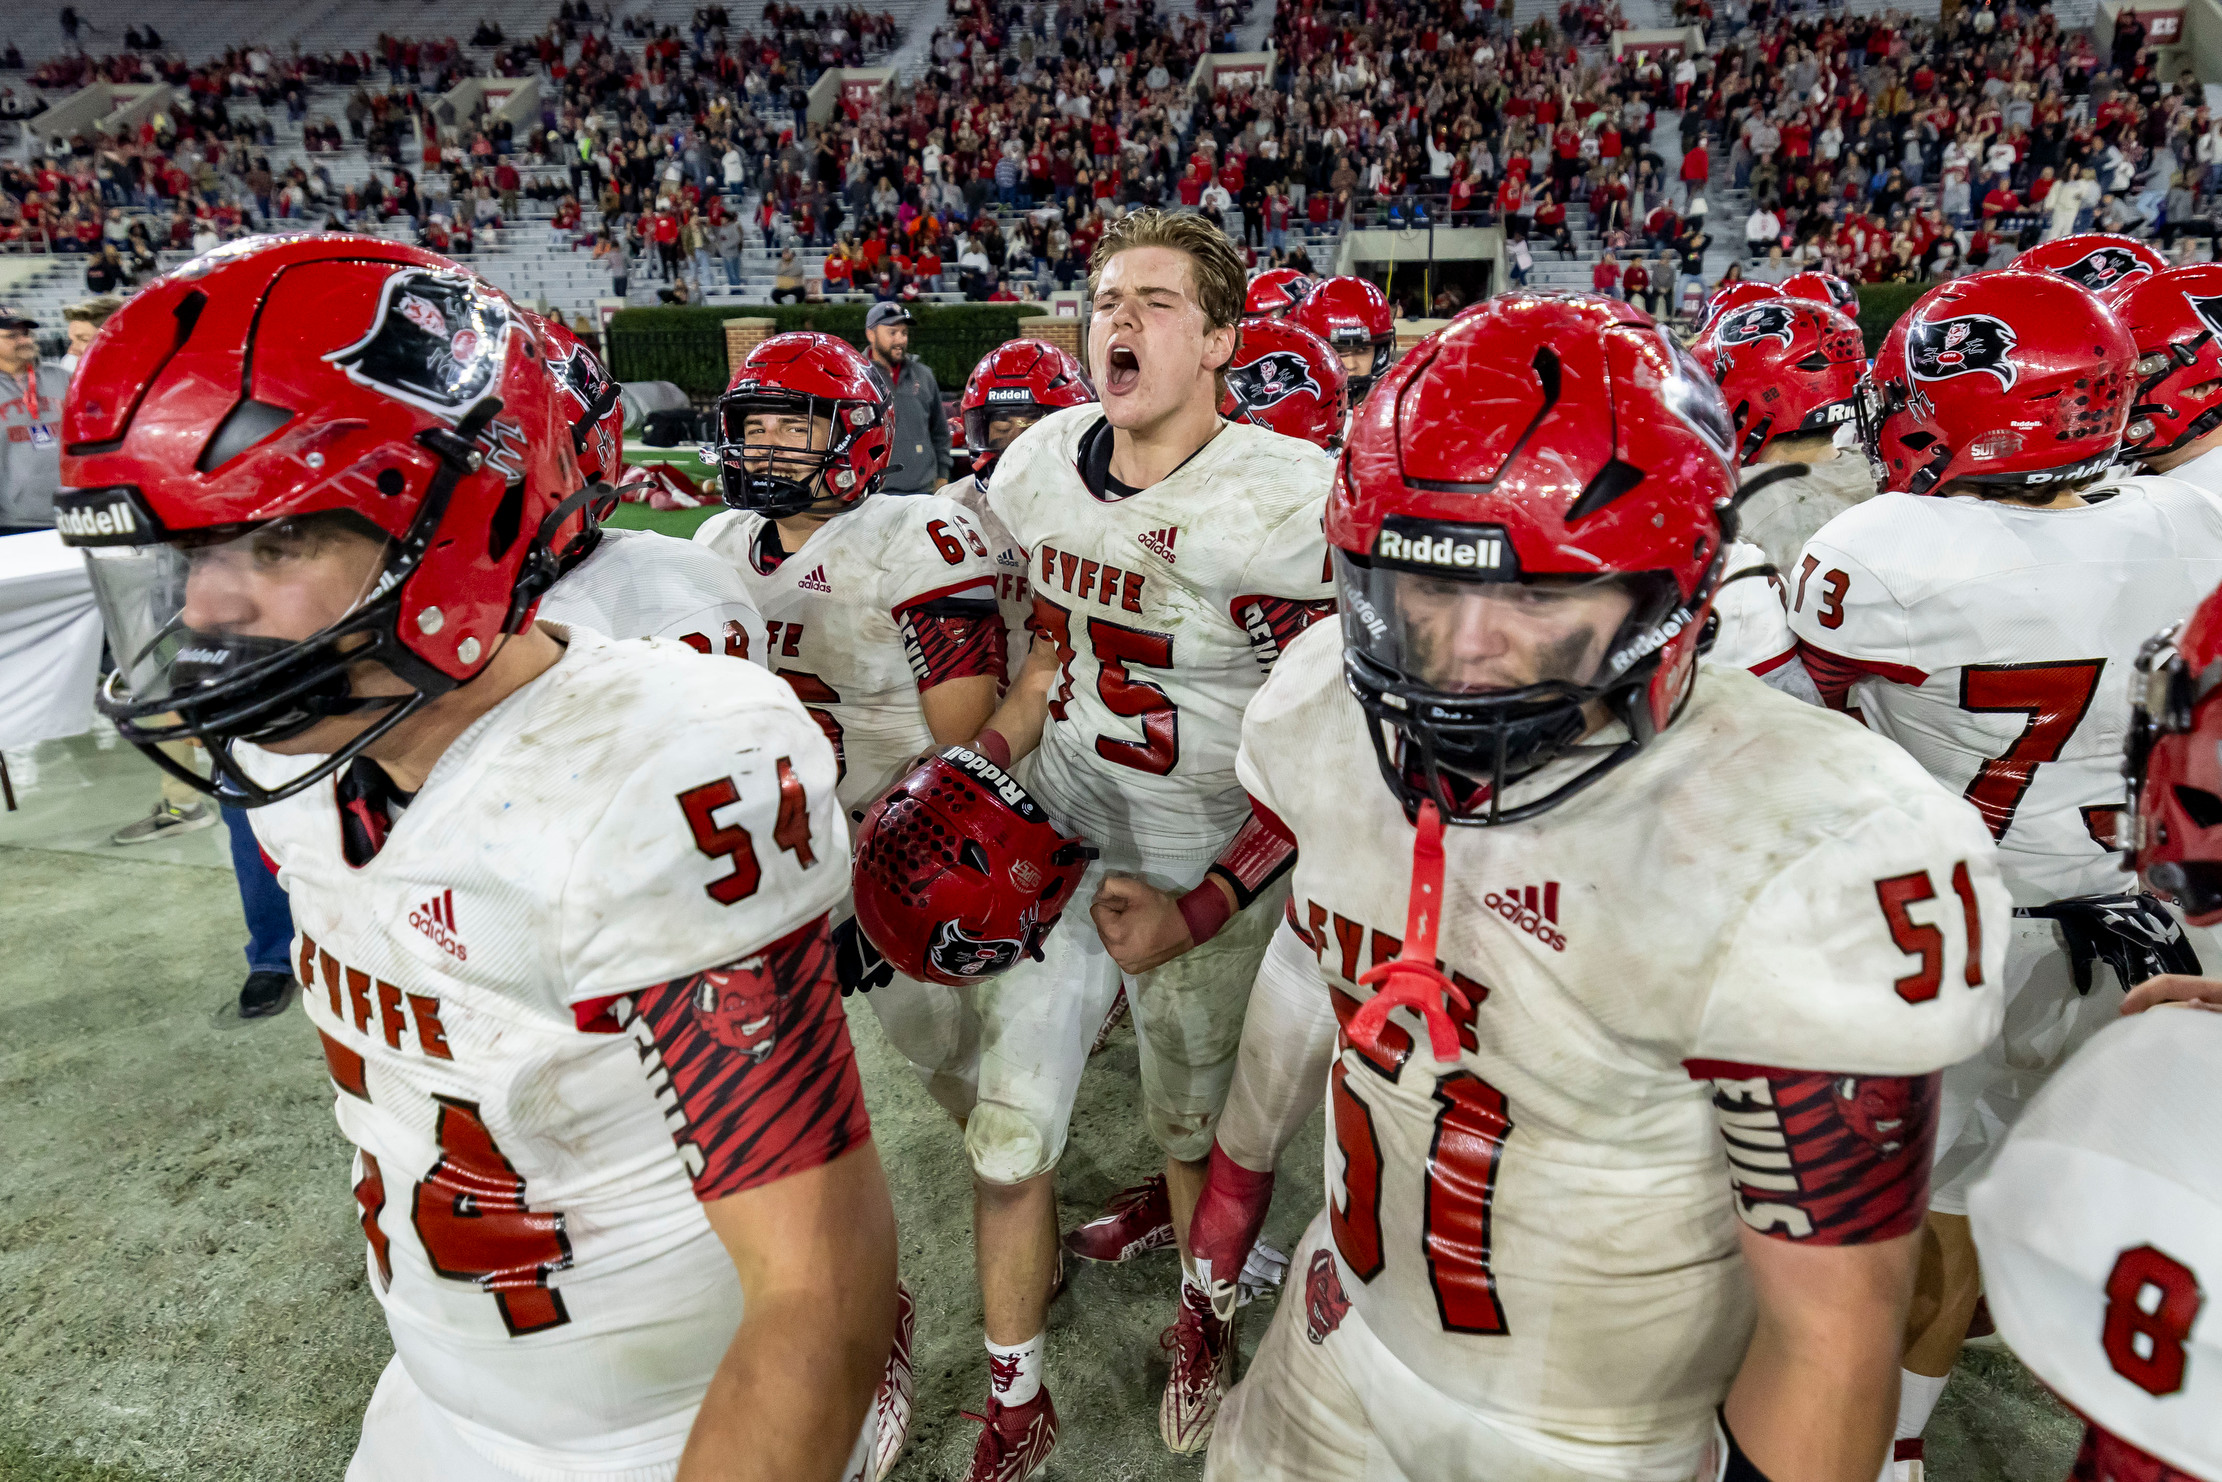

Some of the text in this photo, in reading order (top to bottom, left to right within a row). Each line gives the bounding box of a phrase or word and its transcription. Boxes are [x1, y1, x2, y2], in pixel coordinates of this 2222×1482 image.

[988, 390, 1030, 400] Riddell
[1041, 544, 1146, 614] FYFFE
[1137, 531, 1176, 564] adidas
[1379, 529, 1502, 569] Riddell
[798, 579, 832, 593] adidas
[942, 745, 1026, 806] Riddell
[1958, 657, 2132, 853] 7
[677, 754, 819, 905] 54
[408, 911, 467, 961] adidas
[1484, 892, 1567, 952] adidas
[1875, 860, 1984, 1002] 51
[300, 929, 455, 1062] FYFFE
[1307, 898, 1491, 1055] FYFE
[1713, 1076, 1815, 1238] EVILS
[2099, 1243, 2203, 1396] 8
